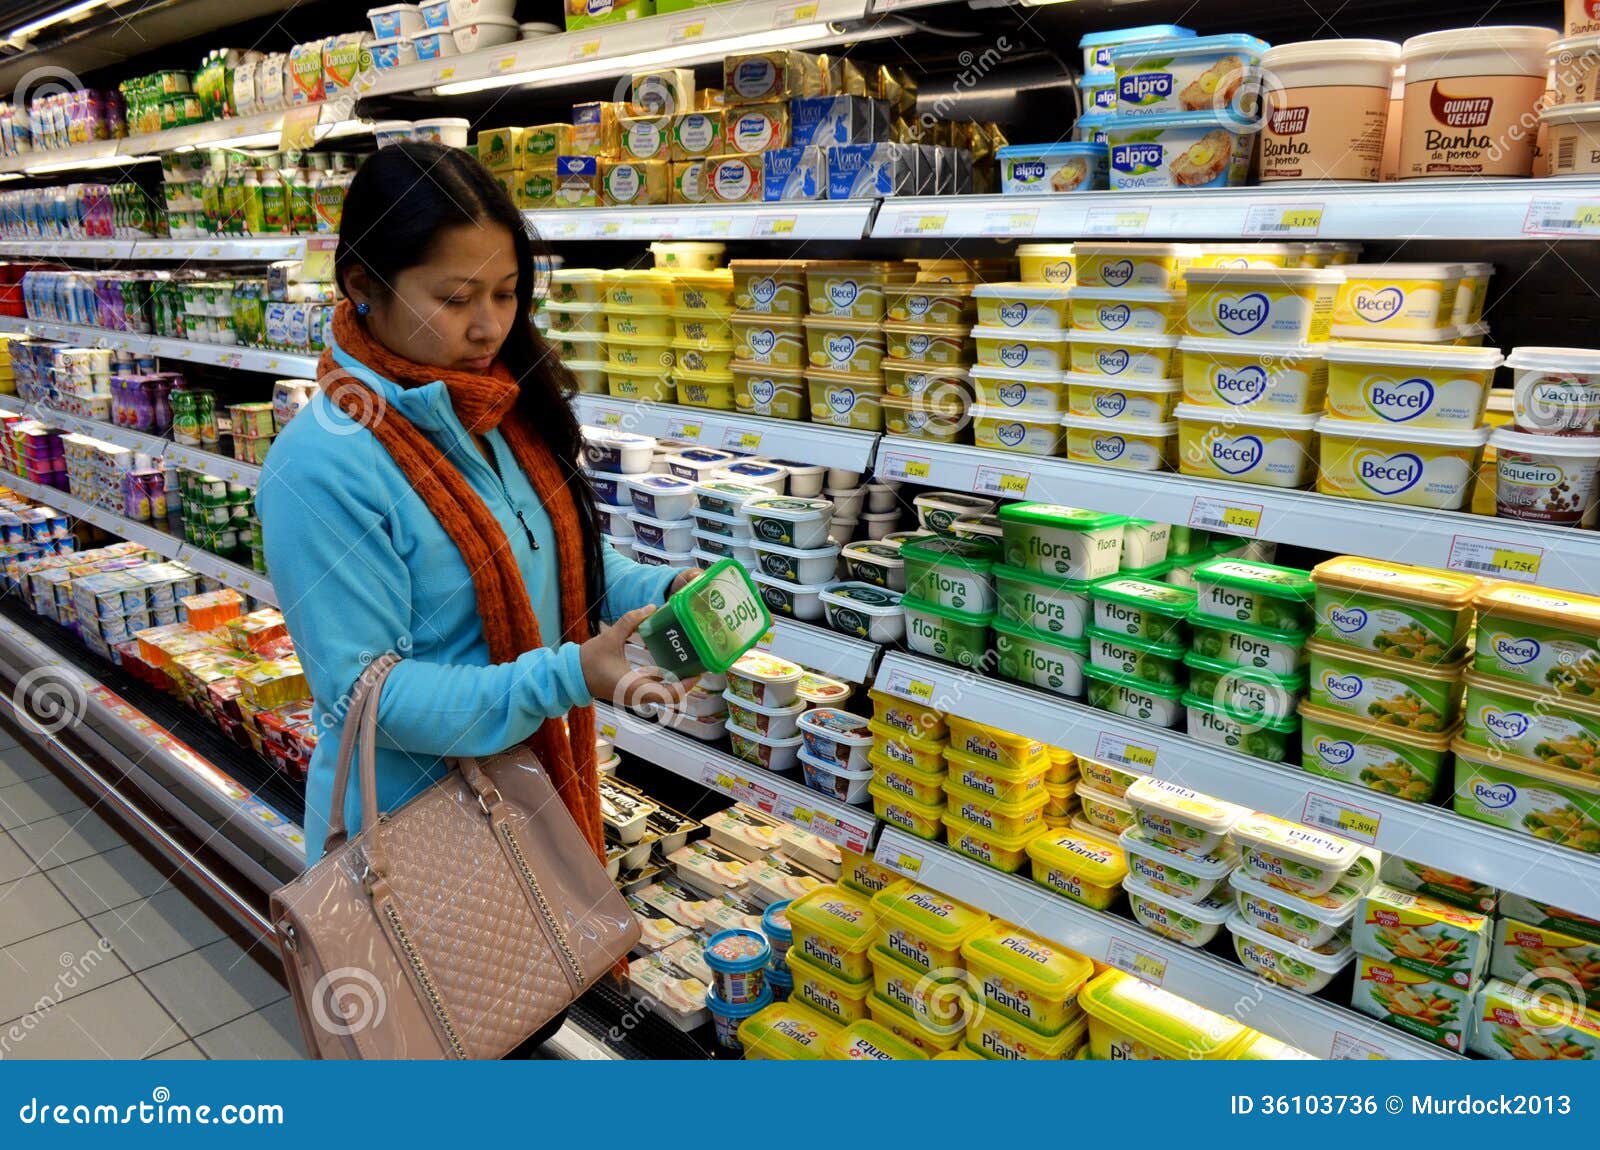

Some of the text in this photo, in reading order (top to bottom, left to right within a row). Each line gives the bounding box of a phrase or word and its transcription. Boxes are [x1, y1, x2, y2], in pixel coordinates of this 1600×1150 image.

[1123, 76, 1169, 97] alpro
[1273, 108, 1306, 121] QUINTA
[1443, 99, 1490, 113] QUINTA
[1274, 121, 1304, 133] VELHA
[1447, 112, 1487, 126] VELHA
[1263, 136, 1311, 157] Banha
[1425, 128, 1493, 151] Banha
[765, 150, 792, 170] Nova
[829, 147, 862, 167] Nova
[1115, 149, 1160, 170] alpro
[1274, 156, 1301, 168] porco
[1446, 150, 1480, 163] porco
[1015, 165, 1044, 178] alpro
[1117, 177, 1147, 188] SOYA
[1103, 265, 1130, 279] Becel
[752, 284, 774, 295] Becel
[831, 287, 854, 299] Becel
[1000, 307, 1026, 320] Becel
[1218, 303, 1261, 322] Becel
[1357, 295, 1396, 311] Becel
[1100, 309, 1127, 323] Becel
[751, 335, 773, 346] Becel
[829, 341, 852, 353] Becel
[1000, 348, 1026, 361] Becel
[1099, 354, 1126, 367] Becel
[752, 385, 773, 396] Becel
[999, 387, 1024, 399] Becel
[1217, 374, 1259, 393] Becel
[830, 394, 853, 406] Becel
[1096, 397, 1123, 411] Becel
[1372, 387, 1425, 408] Becel
[999, 426, 1024, 439] Becel
[1095, 440, 1123, 454] Becel
[1212, 443, 1255, 463] Becel
[1362, 461, 1413, 482] Becel
[1096, 538, 1117, 551] flora
[1150, 528, 1167, 543] flora
[1029, 535, 1072, 561] flora
[928, 572, 967, 597] flora
[1024, 593, 1065, 621] flora
[1211, 587, 1254, 610] flora
[723, 596, 758, 632] flora
[1105, 603, 1142, 625] flora
[1332, 610, 1363, 627] Becel
[912, 617, 949, 644] flora
[665, 628, 689, 662] flora
[1102, 642, 1137, 664] flora
[1229, 633, 1271, 658] flora
[1497, 637, 1534, 659] Becel
[1024, 648, 1065, 676] flora
[1226, 677, 1267, 701] flora
[1327, 677, 1358, 694] Becel
[1118, 686, 1153, 710] flora
[1202, 712, 1243, 738] flora
[1487, 713, 1523, 733] Becel
[886, 744, 914, 766] Planta
[966, 739, 998, 762] Planta
[1318, 742, 1350, 759] Becel
[886, 775, 914, 797] Planta
[962, 774, 995, 796] Planta
[1086, 768, 1112, 784] Planta
[1475, 783, 1511, 804] Becel
[886, 808, 914, 829] Planta
[961, 807, 993, 830] Planta
[1141, 817, 1172, 835] Planta
[960, 839, 991, 862] Planta
[1056, 839, 1107, 864] Planta
[1135, 863, 1165, 882] Planta
[1249, 855, 1283, 875] Planta
[1048, 872, 1081, 897] Planta
[820, 902, 858, 923] Planta
[907, 894, 949, 918] Planta
[1138, 904, 1167, 925] Planta
[1246, 902, 1279, 924] Planta
[804, 940, 842, 970] Planta
[889, 934, 930, 968] Planta
[1001, 937, 1049, 964] Planta
[1243, 947, 1276, 969] Planta
[803, 985, 840, 1016] Planta
[887, 982, 927, 1015] Planta
[983, 981, 1031, 1018] Planta
[774, 1021, 812, 1047] Planta
